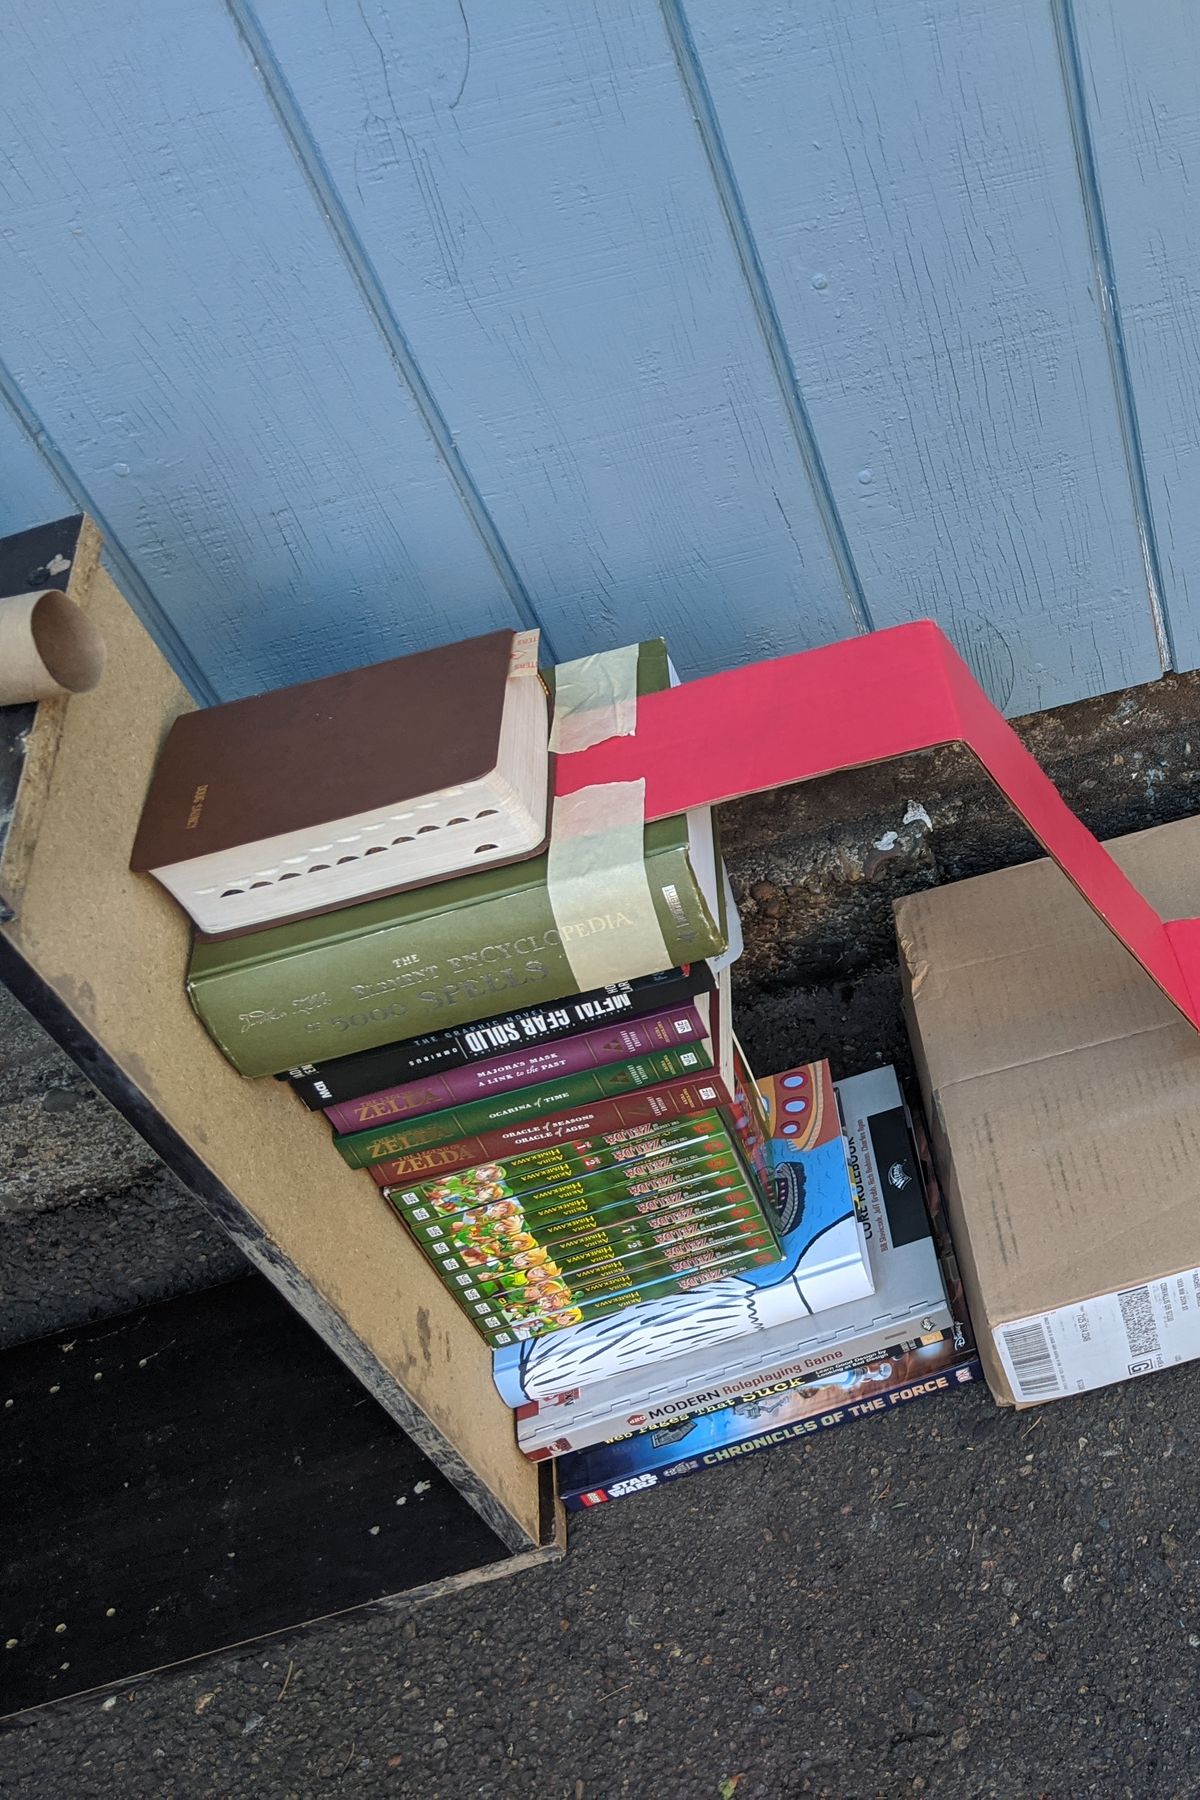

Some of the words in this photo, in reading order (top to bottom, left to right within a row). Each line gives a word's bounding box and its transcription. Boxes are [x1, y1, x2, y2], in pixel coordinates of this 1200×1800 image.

[447, 911, 634, 973] ENCYCLOPEDIA
[392, 953, 420, 968] THE
[328, 1001, 408, 1033] 5000
[417, 959, 551, 1010] SPELLS
[464, 1022, 521, 1052] SOLID
[477, 1061, 526, 1078] MAJORA'S
[529, 1052, 558, 1064] MASK
[487, 1074, 514, 1084] LINK
[526, 1066, 539, 1075] the
[541, 1059, 567, 1070] PAST
[313, 1080, 332, 1099] IDW
[354, 1089, 442, 1122] ZELDA
[489, 1103, 532, 1119] OCARINA
[534, 1098, 541, 1107] of
[543, 1092, 570, 1102] TIME
[502, 1126, 541, 1139] ORACLE
[542, 1121, 550, 1132] of
[552, 1114, 595, 1128] SEASONS
[514, 1131, 554, 1144] ORACLE
[555, 1128, 563, 1137] of
[565, 1123, 590, 1134] AGES
[391, 1148, 476, 1176] ZELDA
[817, 1368, 844, 1378] Looking
[866, 1352, 889, 1363] Design
[835, 1360, 852, 1369] Good
[853, 1354, 877, 1364] Design
[878, 1349, 887, 1357] by
[1131, 1363, 1149, 1373] G
[648, 1389, 720, 1420] MODERN
[722, 1364, 802, 1396] Roleplaying
[804, 1351, 843, 1367] Game
[694, 1398, 736, 1416] That
[740, 1376, 806, 1403] Suck
[703, 1419, 818, 1466] CHRONICLES
[820, 1411, 846, 1426] OF
[848, 1397, 886, 1416] THE
[889, 1376, 949, 1404] FORCE
[607, 1480, 657, 1498] WARS
[612, 1473, 658, 1489] STAR
